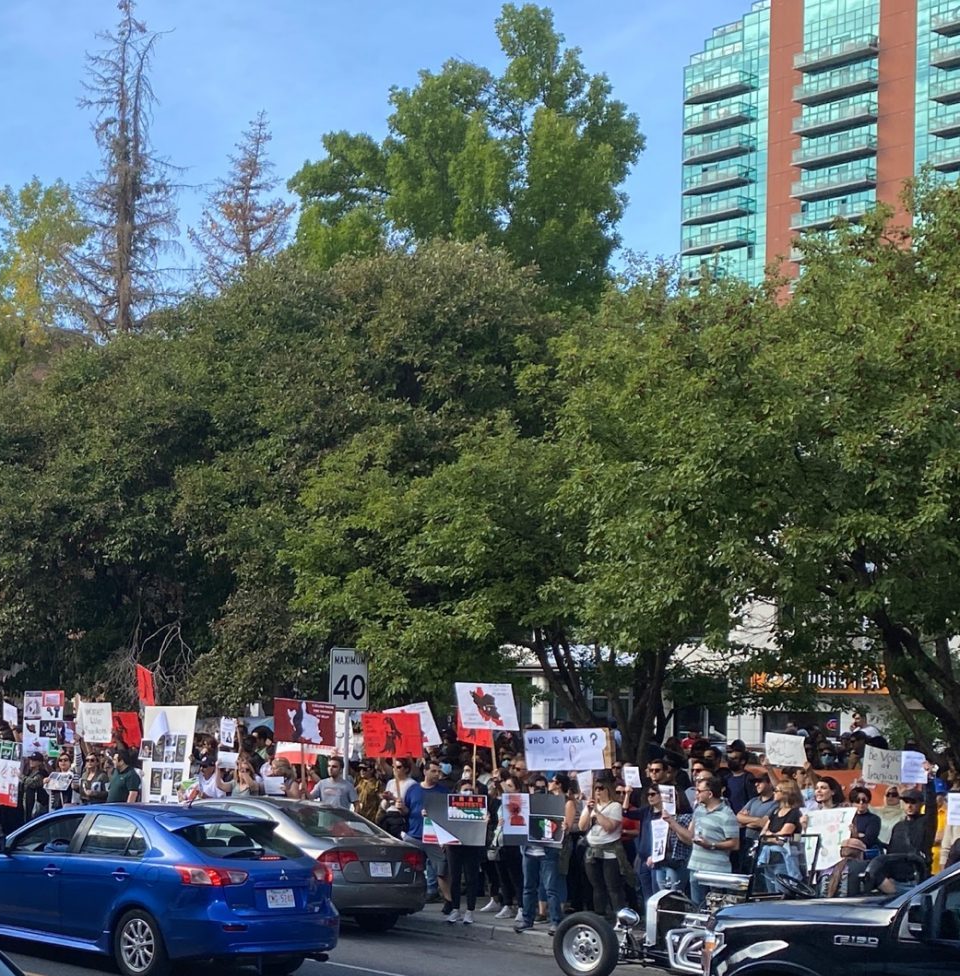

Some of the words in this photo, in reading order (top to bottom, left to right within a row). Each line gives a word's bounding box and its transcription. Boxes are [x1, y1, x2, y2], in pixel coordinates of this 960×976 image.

[334, 655, 366, 665] MAXIMUM
[333, 674, 366, 700] 40
[528, 736, 545, 745] WHO
